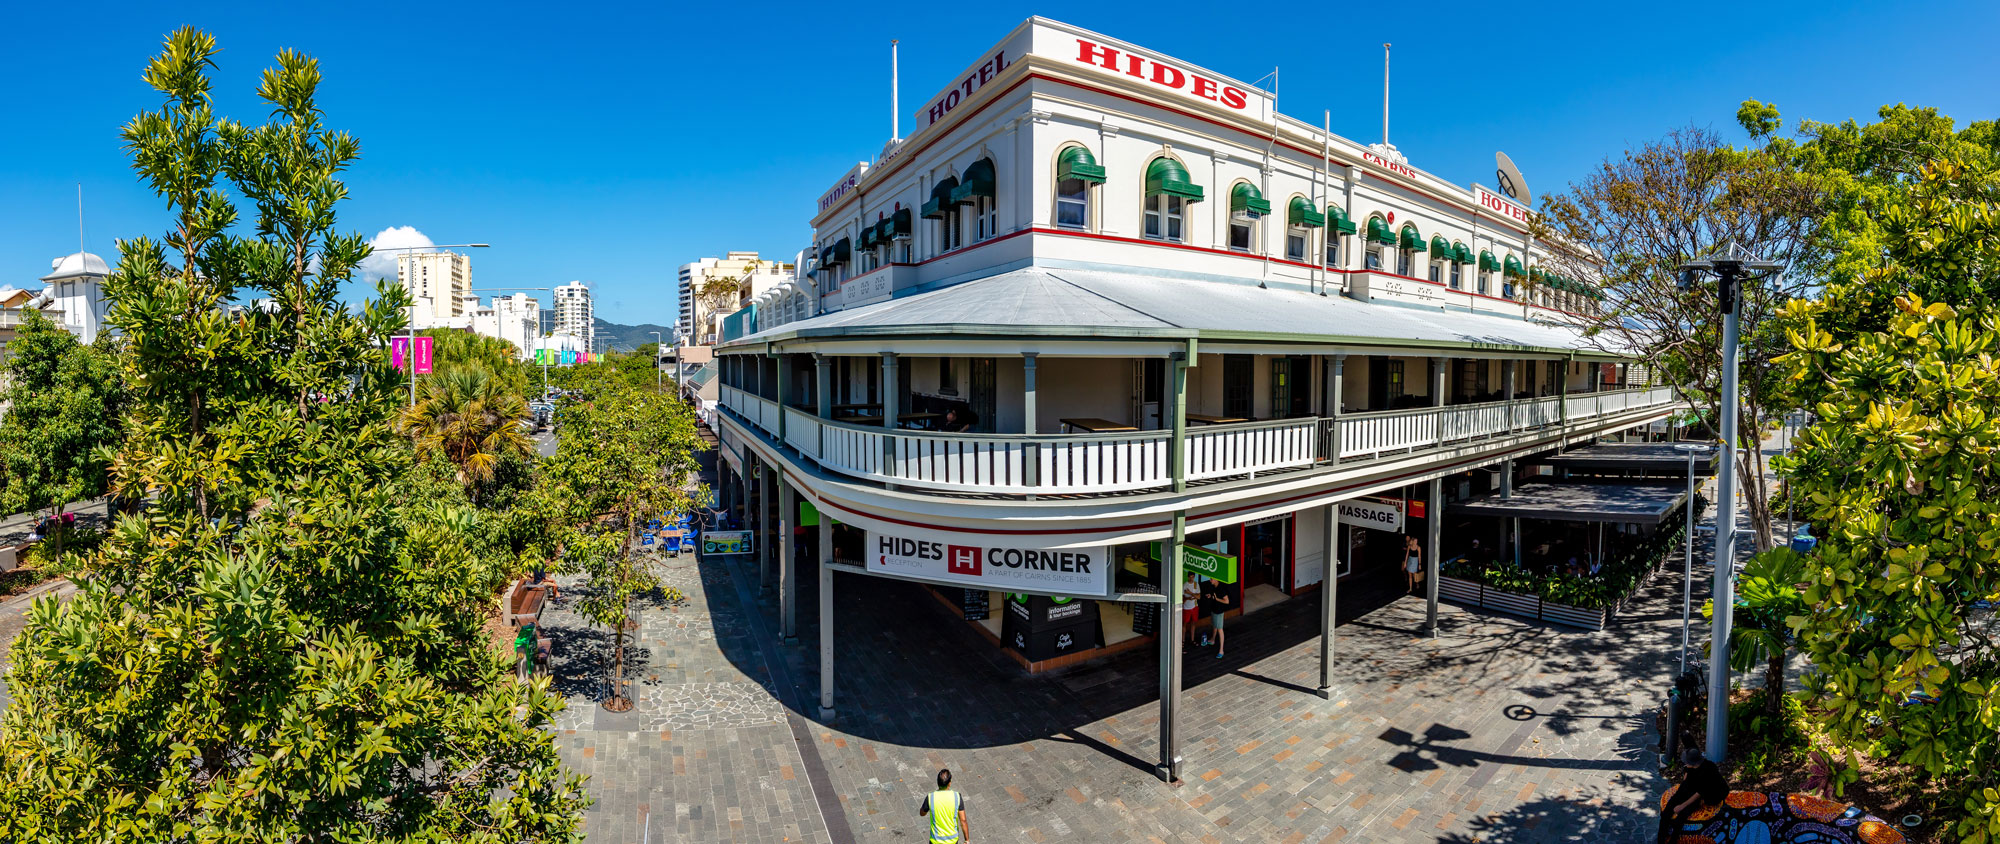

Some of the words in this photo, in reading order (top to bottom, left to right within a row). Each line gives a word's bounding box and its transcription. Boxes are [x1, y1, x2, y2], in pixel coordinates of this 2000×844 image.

[928, 49, 1011, 127] HOTEL
[1076, 38, 1248, 110] HIDES
[1363, 152, 1416, 179] CAIRNS
[822, 174, 856, 211] HIDES
[1481, 191, 1530, 223] HOTEL
[1338, 504, 1394, 524] MASSAGE
[880, 536, 942, 560] HIDES
[955, 549, 974, 569] H
[987, 547, 1091, 574] CORNER
[888, 558, 923, 568] RECEPTION
[1025, 572, 1051, 580] CAIRNS
[1052, 574, 1074, 582] SINCE
[1076, 576, 1092, 584] 1885
